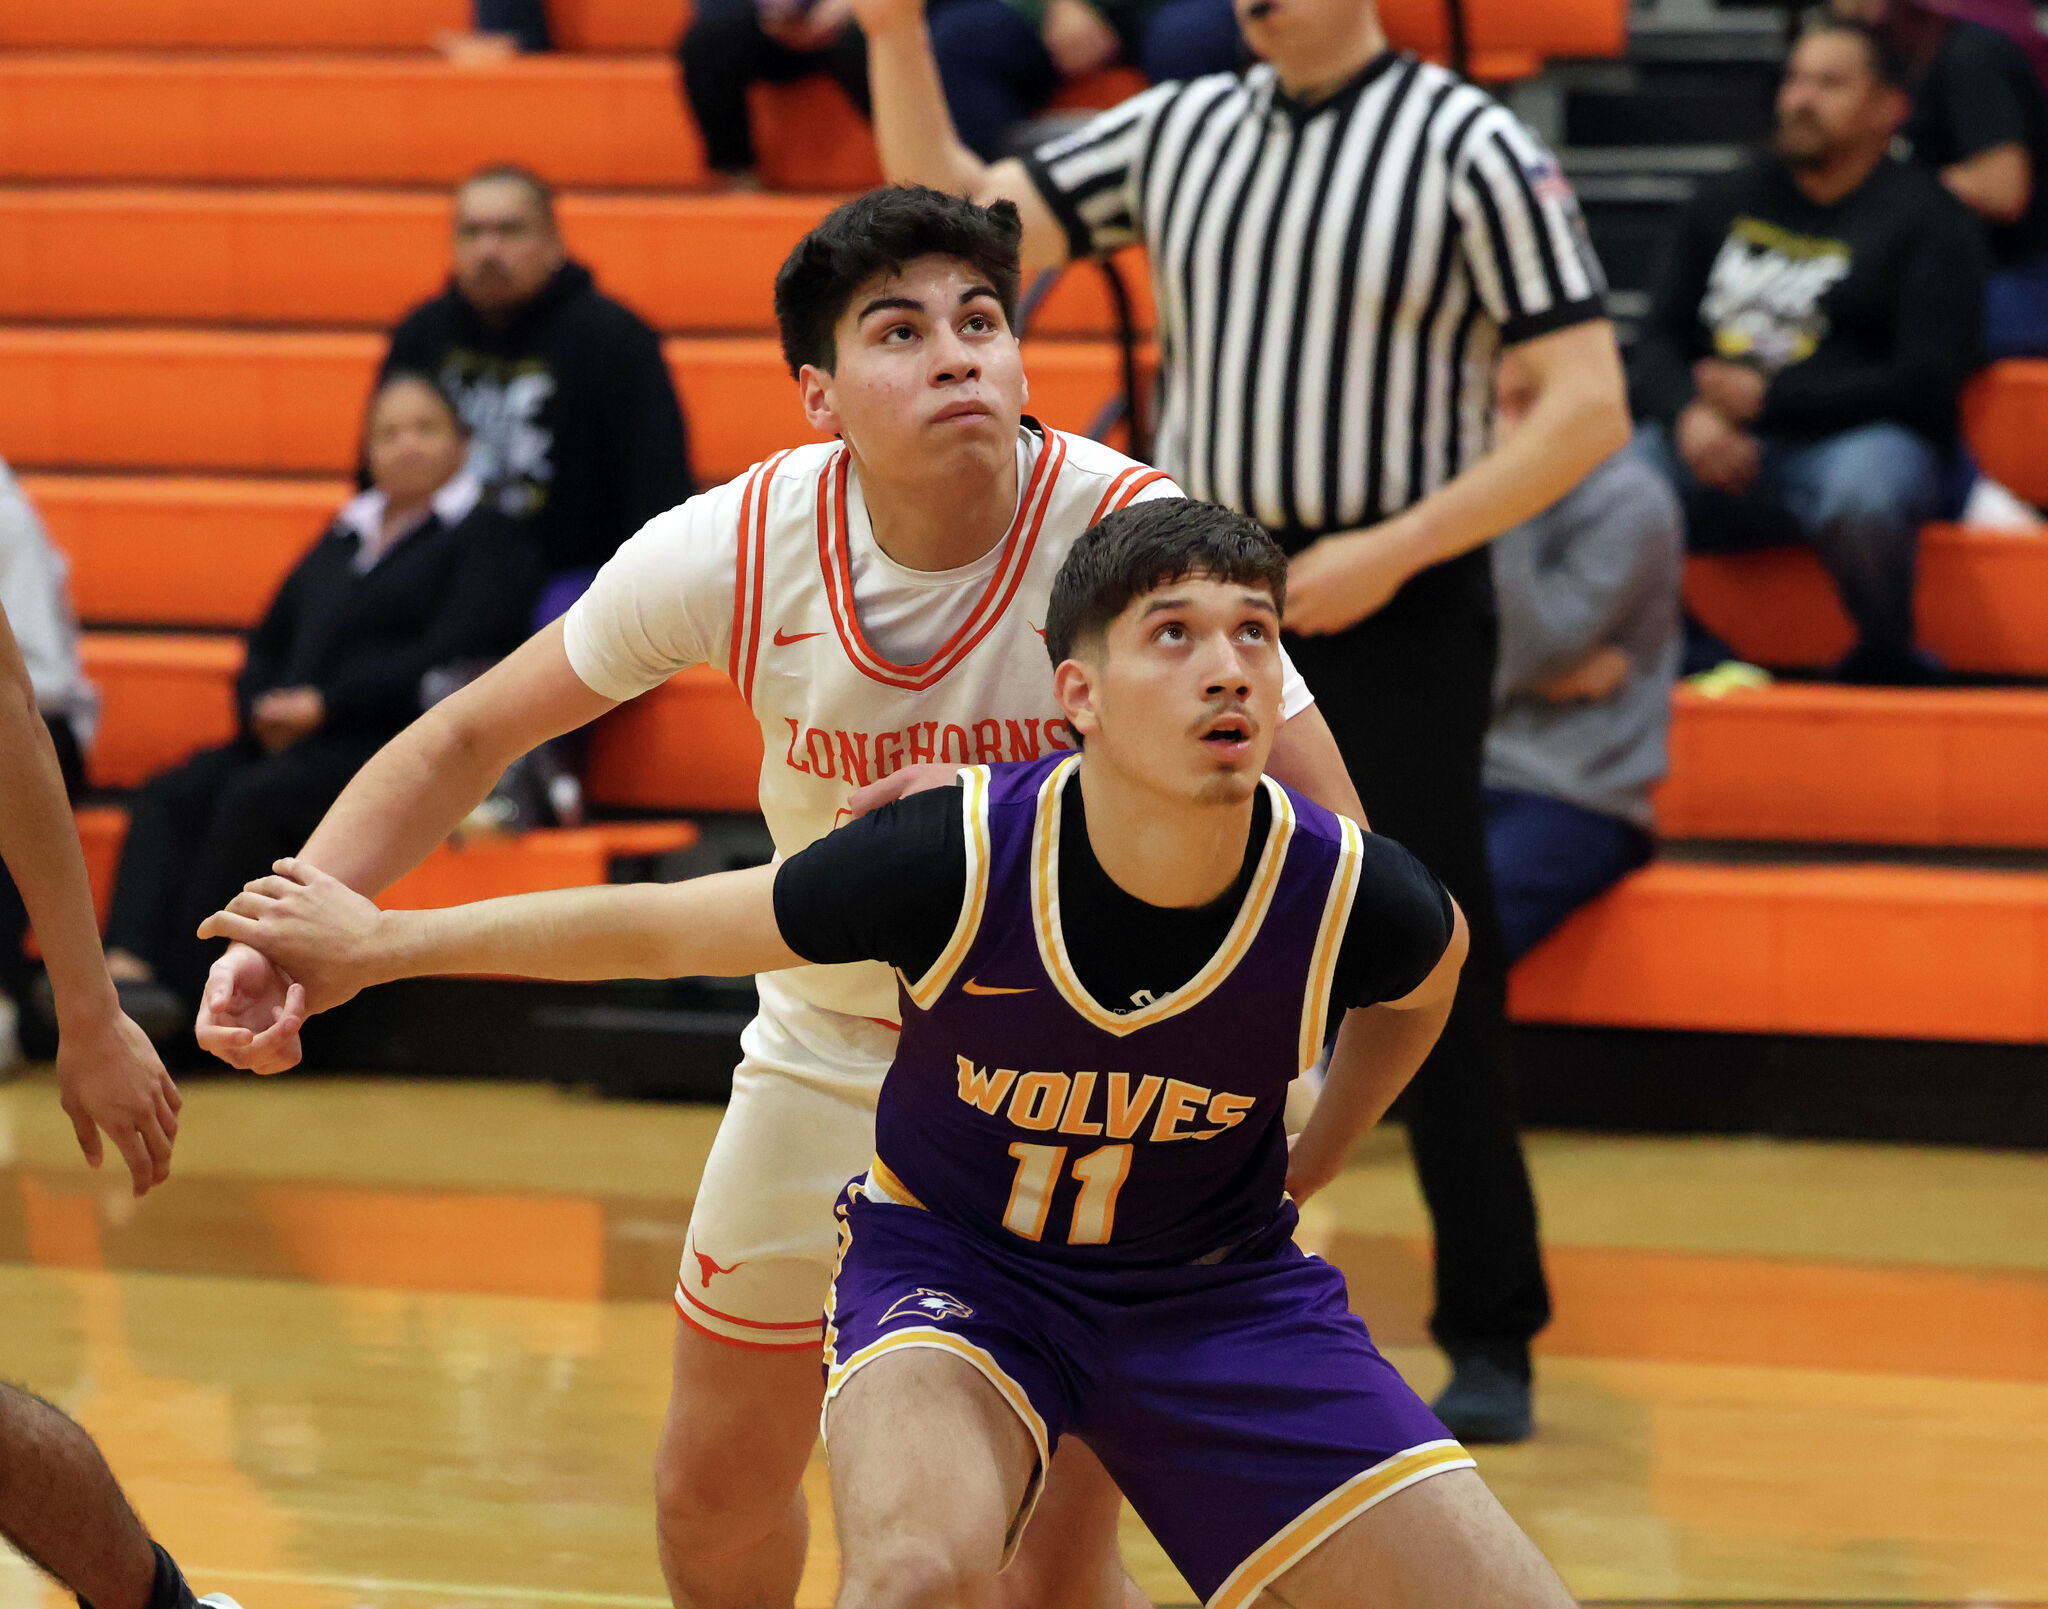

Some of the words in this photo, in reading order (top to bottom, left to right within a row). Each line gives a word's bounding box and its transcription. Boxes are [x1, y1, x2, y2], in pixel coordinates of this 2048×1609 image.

[784, 717, 1070, 787] LONGHORNS
[957, 1054, 1256, 1142] WOLVES
[1002, 1142, 1134, 1245] 11
